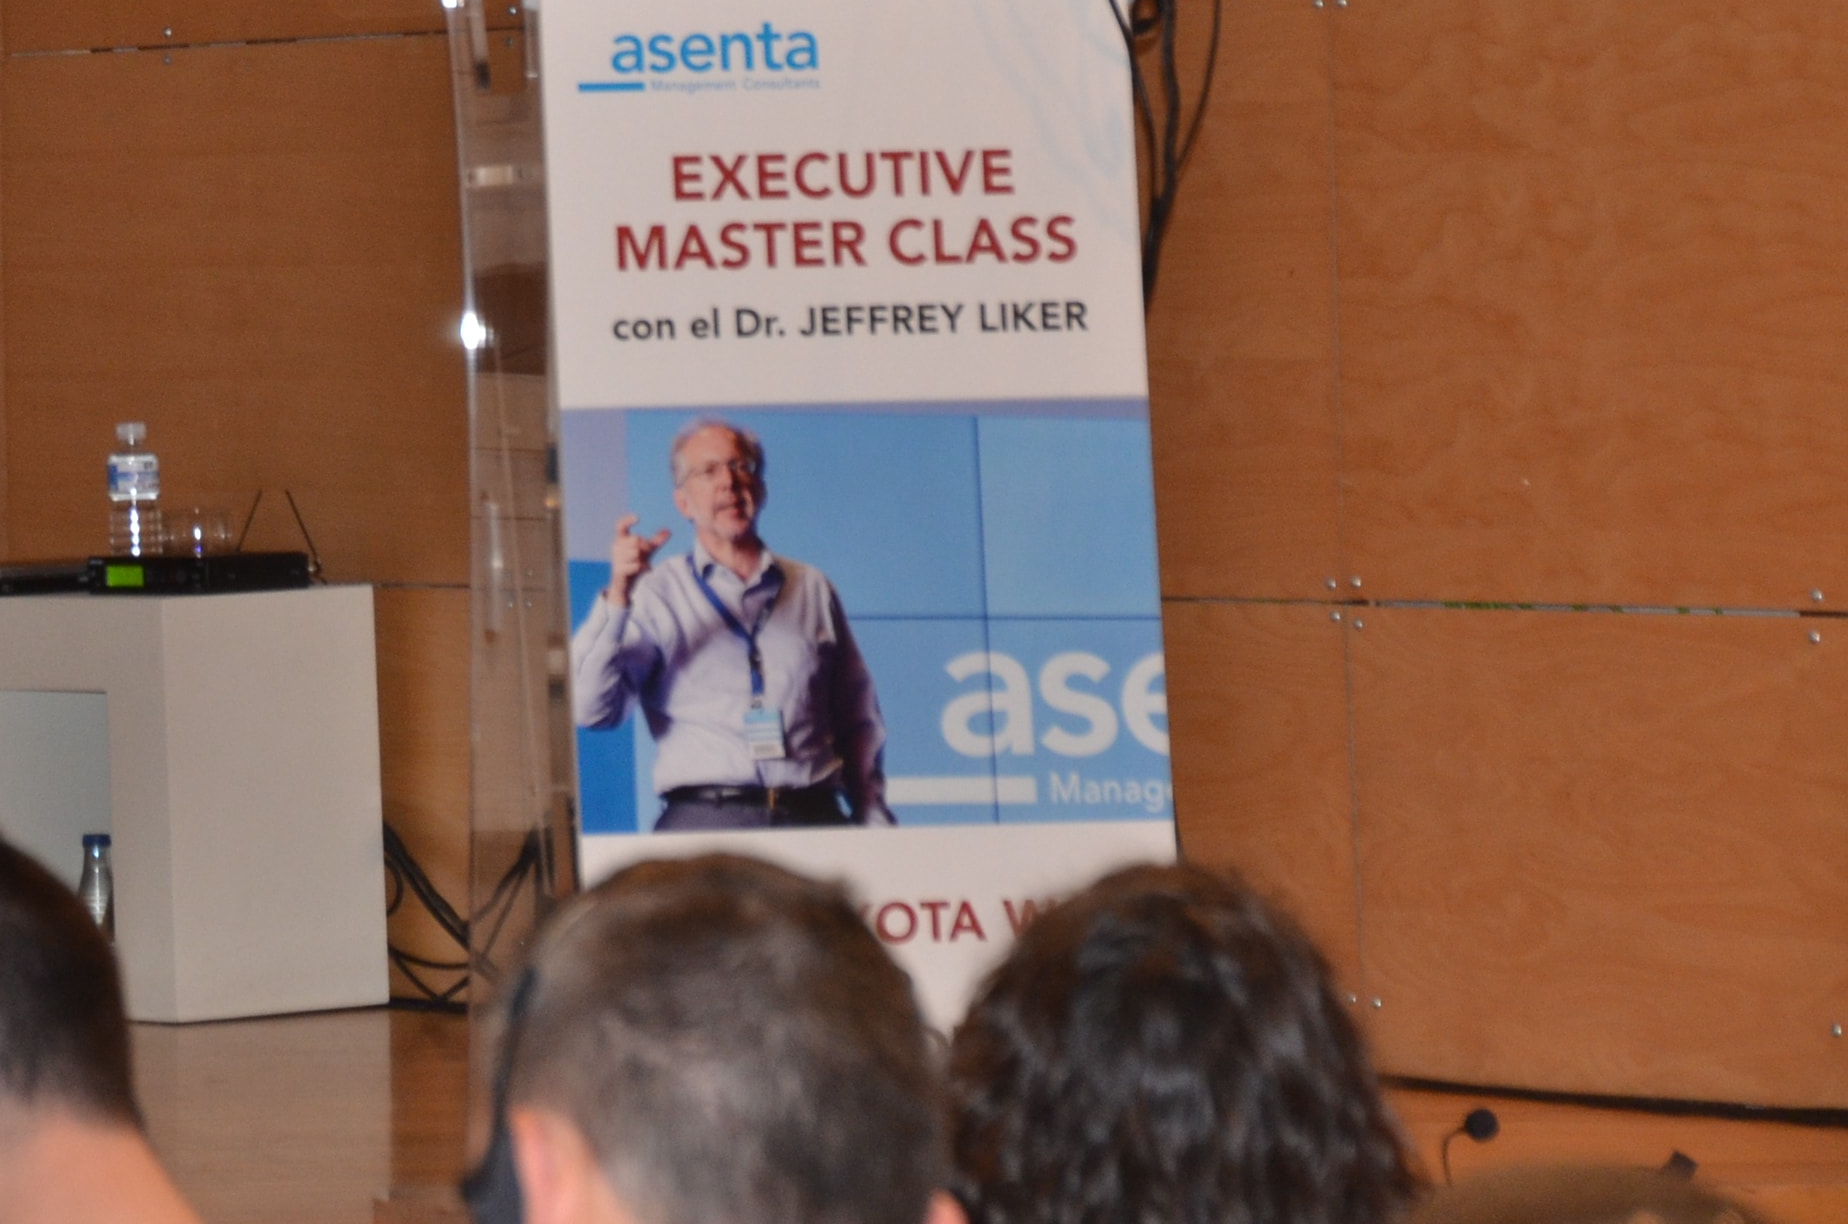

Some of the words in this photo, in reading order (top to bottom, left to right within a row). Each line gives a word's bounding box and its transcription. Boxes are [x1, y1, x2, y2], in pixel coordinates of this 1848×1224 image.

[611, 21, 820, 74] asenta
[671, 147, 1015, 201] EXECUTIVE
[616, 219, 867, 271] MASTER
[888, 214, 1079, 267] CLASS
[612, 318, 676, 340] con
[689, 307, 720, 339] el
[735, 306, 786, 338] Dr.
[799, 302, 964, 337] JEFFREY
[979, 300, 1088, 332] LIKER
